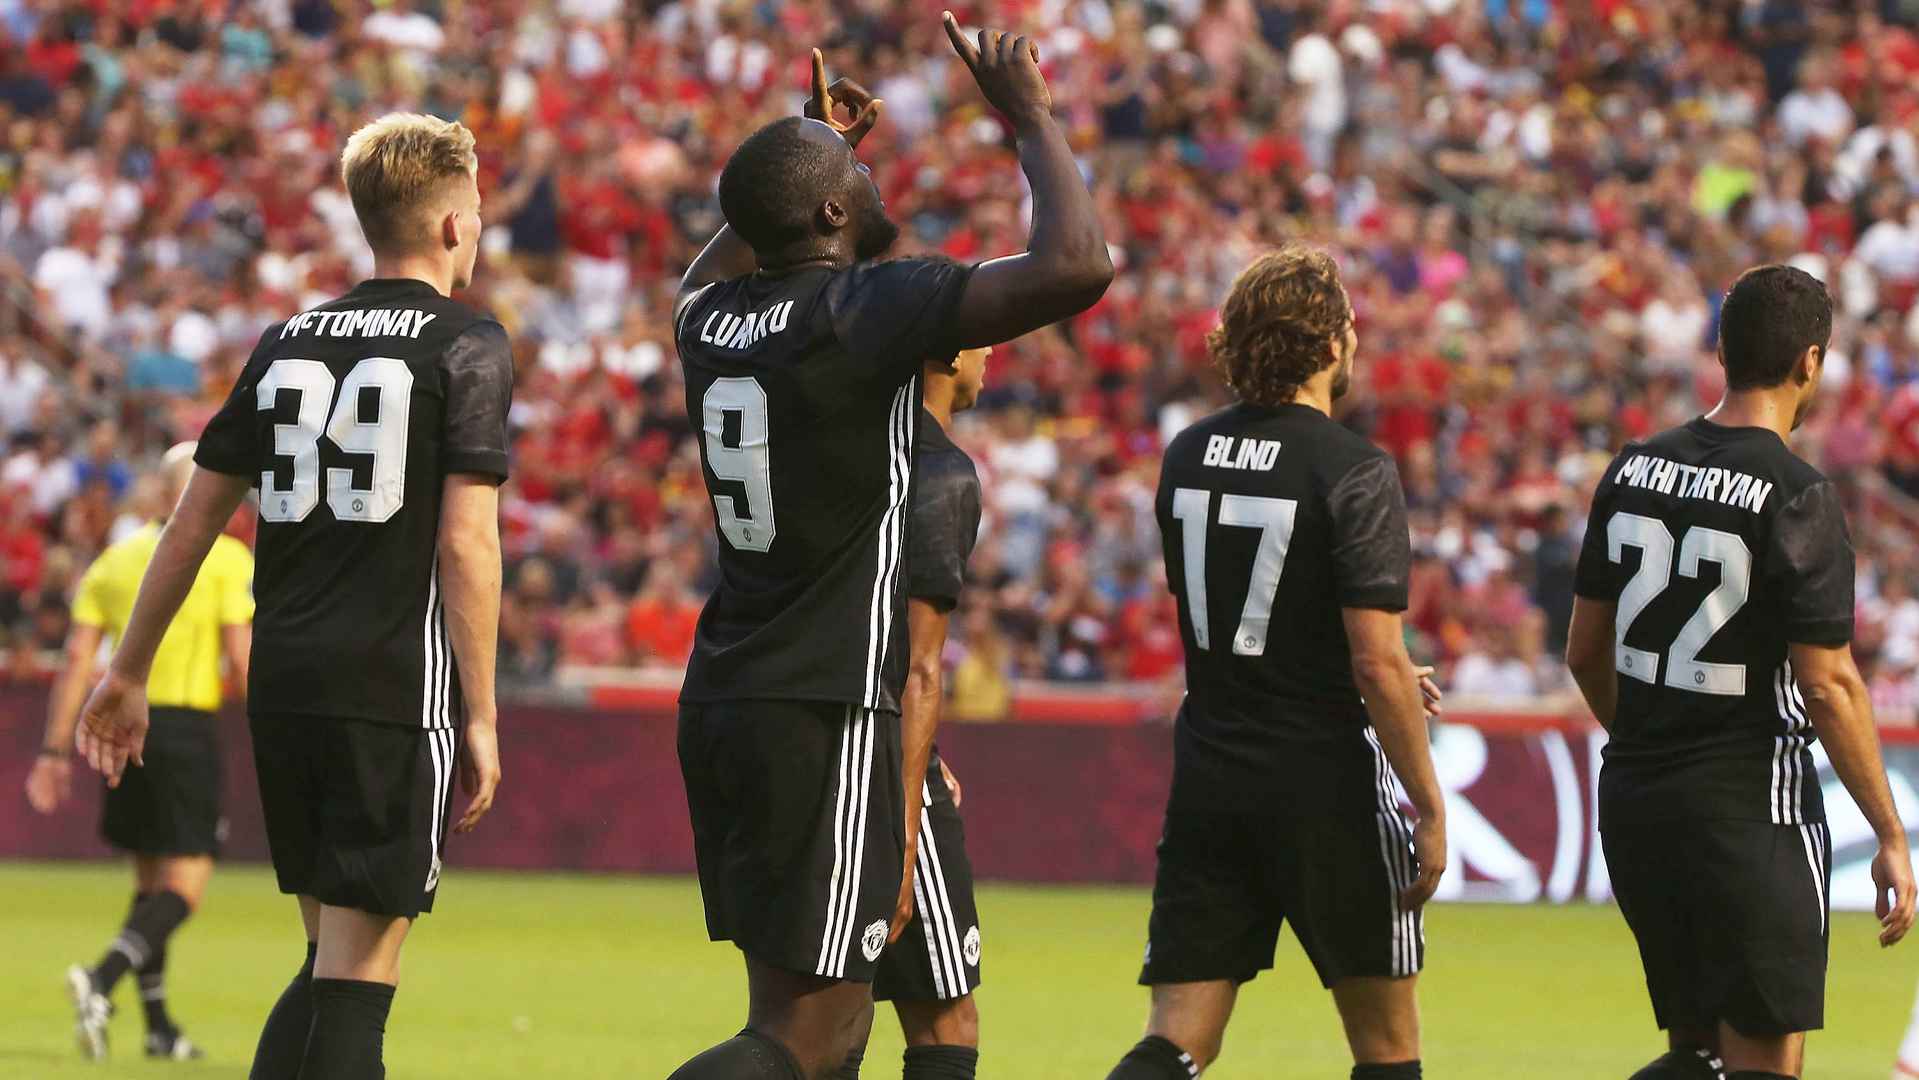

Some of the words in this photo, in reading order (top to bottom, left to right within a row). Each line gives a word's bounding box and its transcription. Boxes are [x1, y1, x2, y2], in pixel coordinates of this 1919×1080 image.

[256, 357, 414, 523] 39
[703, 376, 776, 552] 9
[1203, 434, 1281, 471] BLIND
[1614, 455, 1774, 514] MKHITARYAN
[1172, 488, 1298, 656] 17
[1606, 511, 1752, 696] 22
